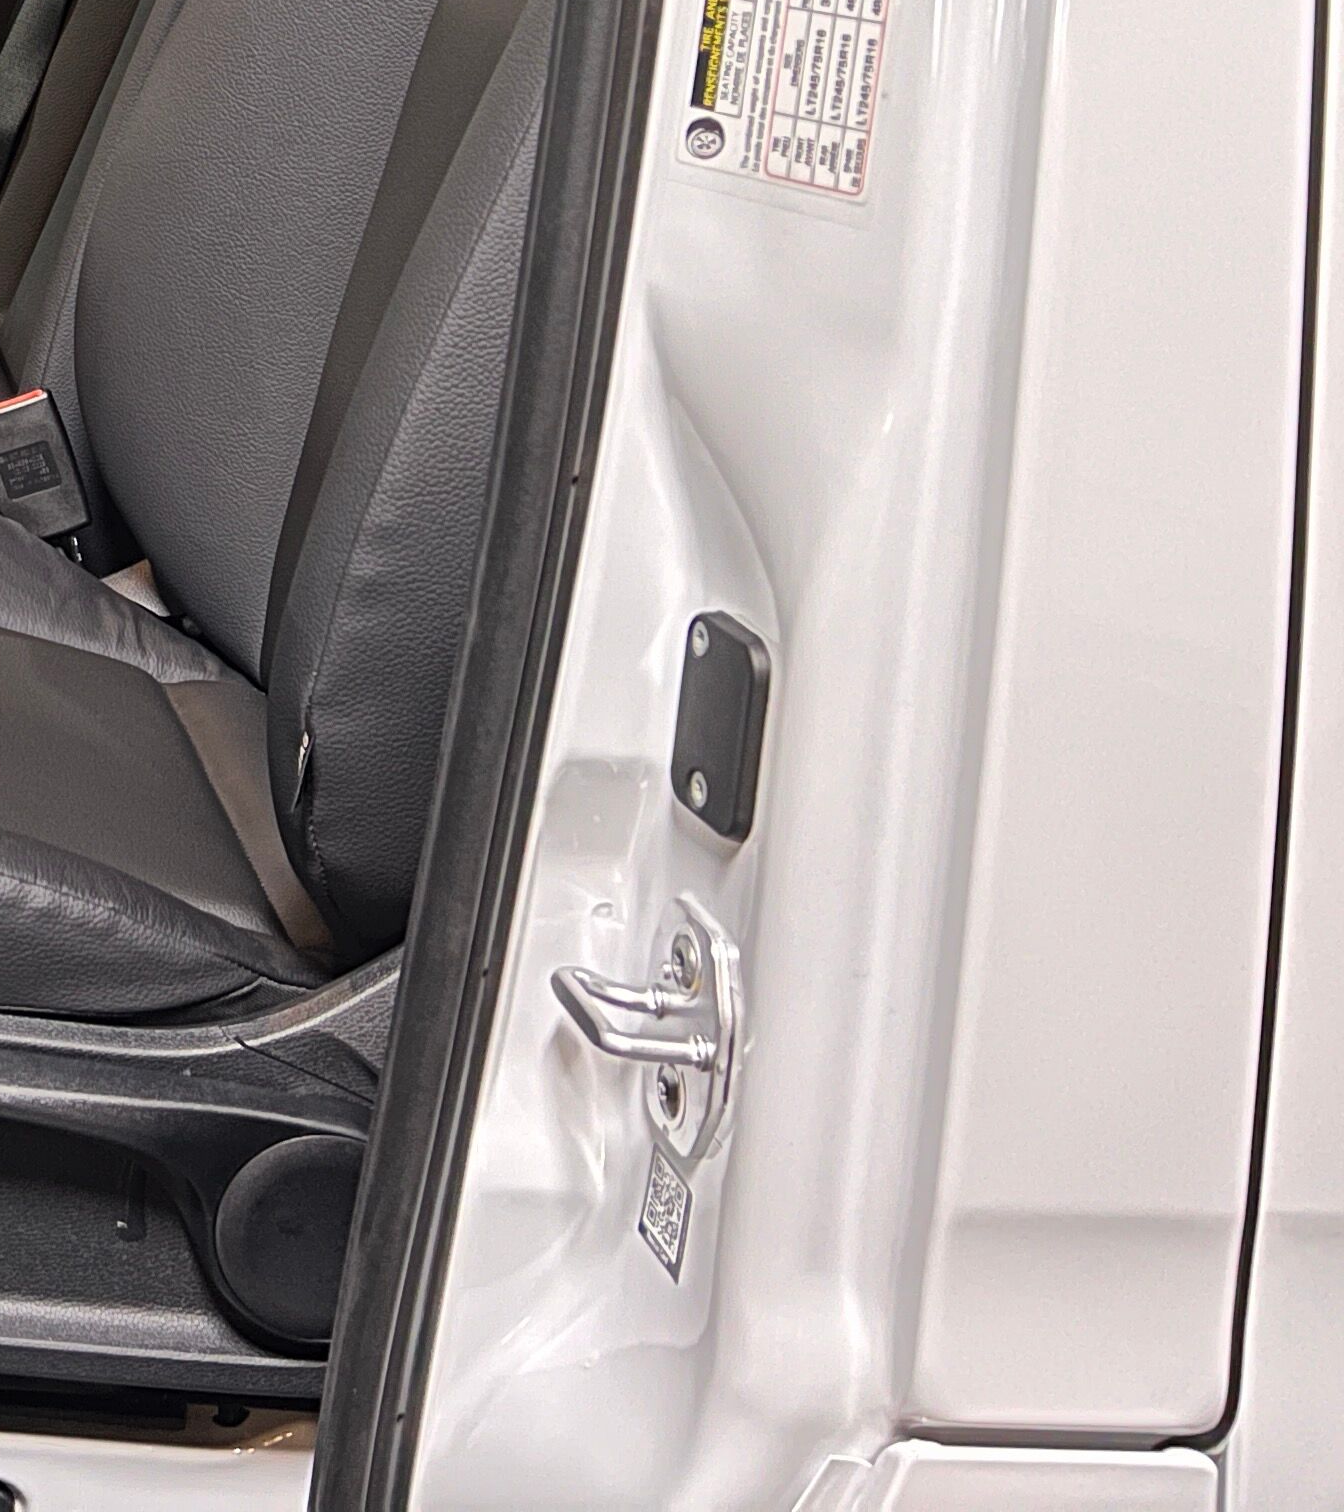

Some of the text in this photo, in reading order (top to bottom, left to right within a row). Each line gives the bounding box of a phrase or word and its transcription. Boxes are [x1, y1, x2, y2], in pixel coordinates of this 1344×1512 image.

[700, 26, 712, 51] TIRE
[703, 5, 727, 106] RENSEIGNEMENTS
[719, 11, 740, 100] SEATING CAPACITY
[735, 51, 745, 63] DE
[737, 10, 751, 48] PLACES
[805, 28, 826, 115] LT245/75R16
[830, 33, 851, 120] LT245/75R16
[855, 37, 877, 126] LT245/75R16
